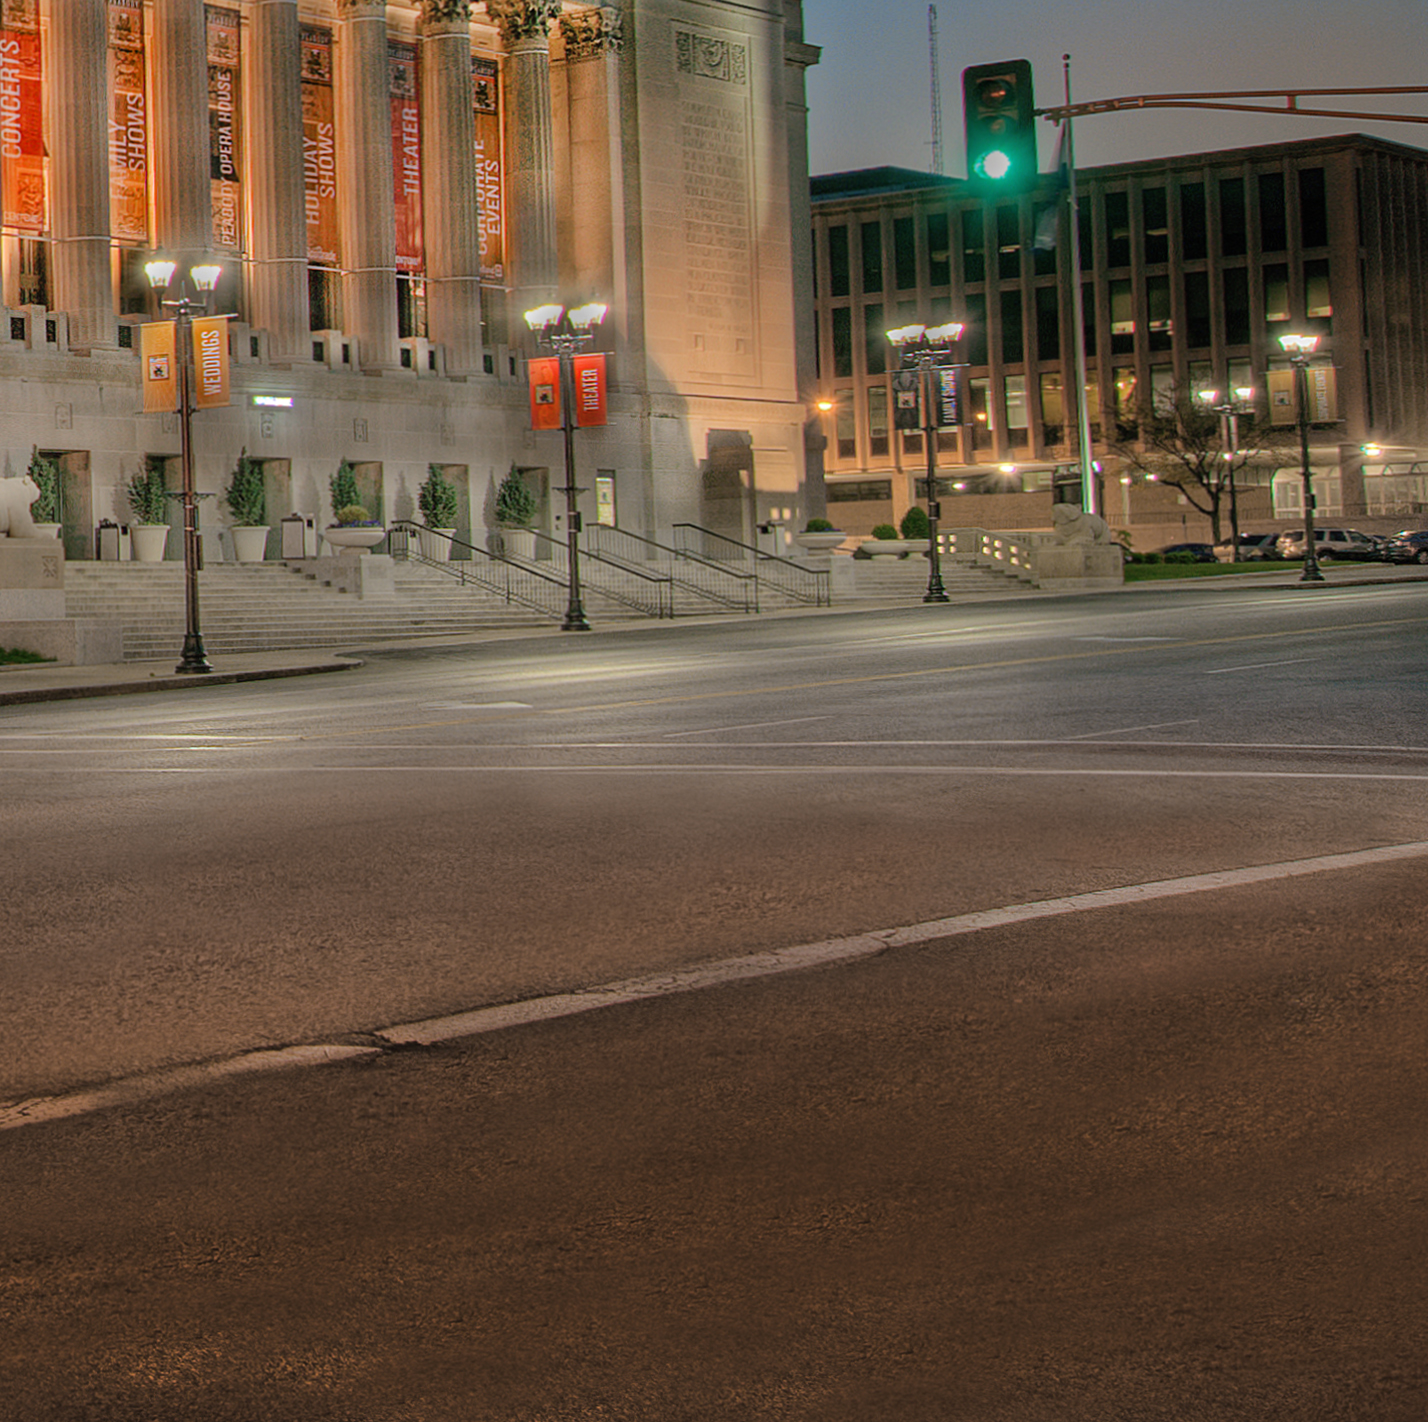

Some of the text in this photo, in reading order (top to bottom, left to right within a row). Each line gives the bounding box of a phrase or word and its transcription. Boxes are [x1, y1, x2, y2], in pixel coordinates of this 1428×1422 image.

[126, 92, 145, 172] SHOWS
[217, 71, 232, 123] HOUSE
[219, 126, 234, 175] OPERA
[318, 122, 336, 199] SHOWS
[402, 108, 419, 196] THEATER
[485, 160, 500, 236] EVENTS
[201, 330, 222, 396] WEDDINGS
[581, 368, 599, 411] THEATER
